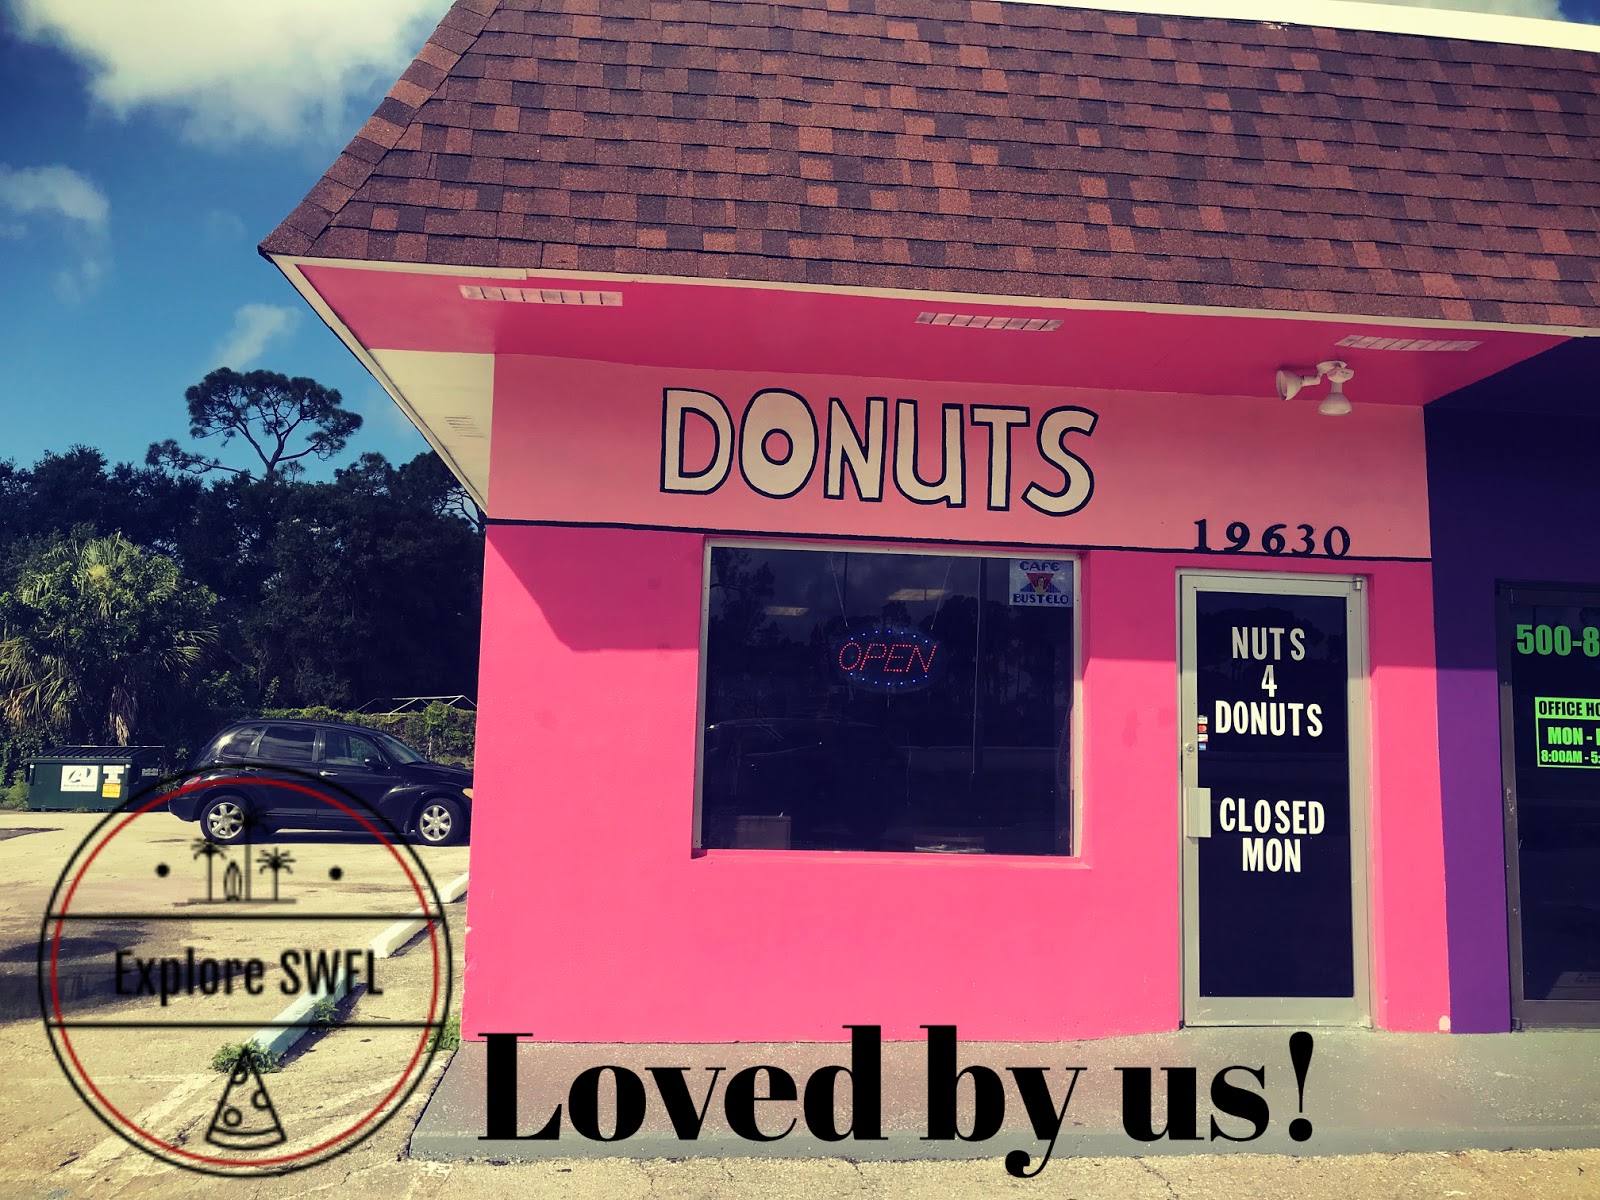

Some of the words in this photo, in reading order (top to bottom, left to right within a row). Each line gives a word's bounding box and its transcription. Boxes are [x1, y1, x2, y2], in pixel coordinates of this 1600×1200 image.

[660, 387, 1098, 517] DONUTS
[1194, 519, 1351, 558] 19630
[1019, 561, 1060, 571] CAFE
[1012, 593, 1069, 604] BUSTELO
[1232, 627, 1305, 661] NUTS
[1516, 624, 1600, 657] 500-8
[838, 642, 937, 674] OPEN
[1261, 665, 1277, 697] 4
[1215, 700, 1323, 737] DONUTS
[1538, 700, 1582, 717] OFFICE
[1547, 726, 1583, 746] MON
[1541, 749, 1582, 764] 8:00AM
[1219, 797, 1325, 835] CLOSED
[1242, 837, 1301, 873] MON
